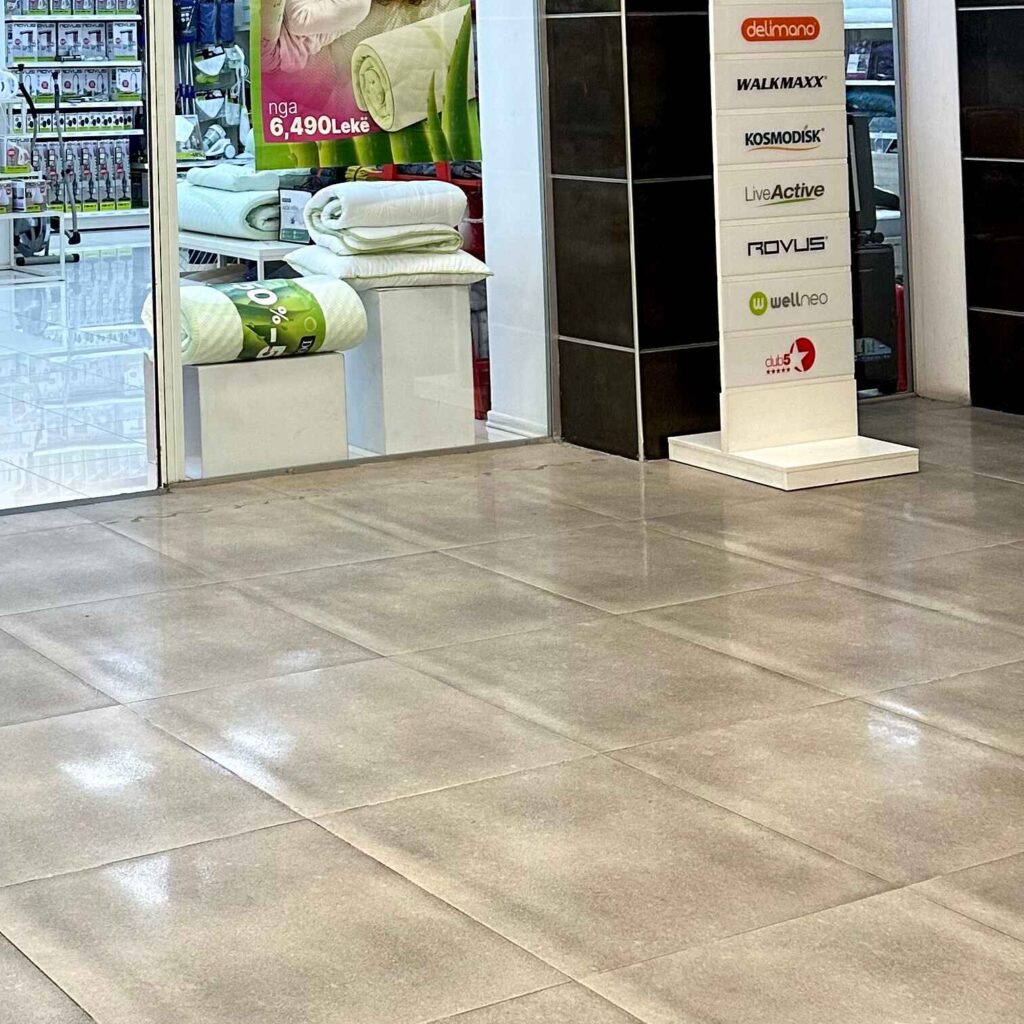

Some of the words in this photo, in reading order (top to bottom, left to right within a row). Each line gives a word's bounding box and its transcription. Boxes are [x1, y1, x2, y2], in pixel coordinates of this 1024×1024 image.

[746, 19, 816, 38] delimano
[736, 76, 824, 91] WALKMAXX
[268, 102, 298, 118] nga
[744, 182, 825, 202] LiveActive
[747, 236, 826, 257] ROVUS
[770, 291, 829, 309] wellneo
